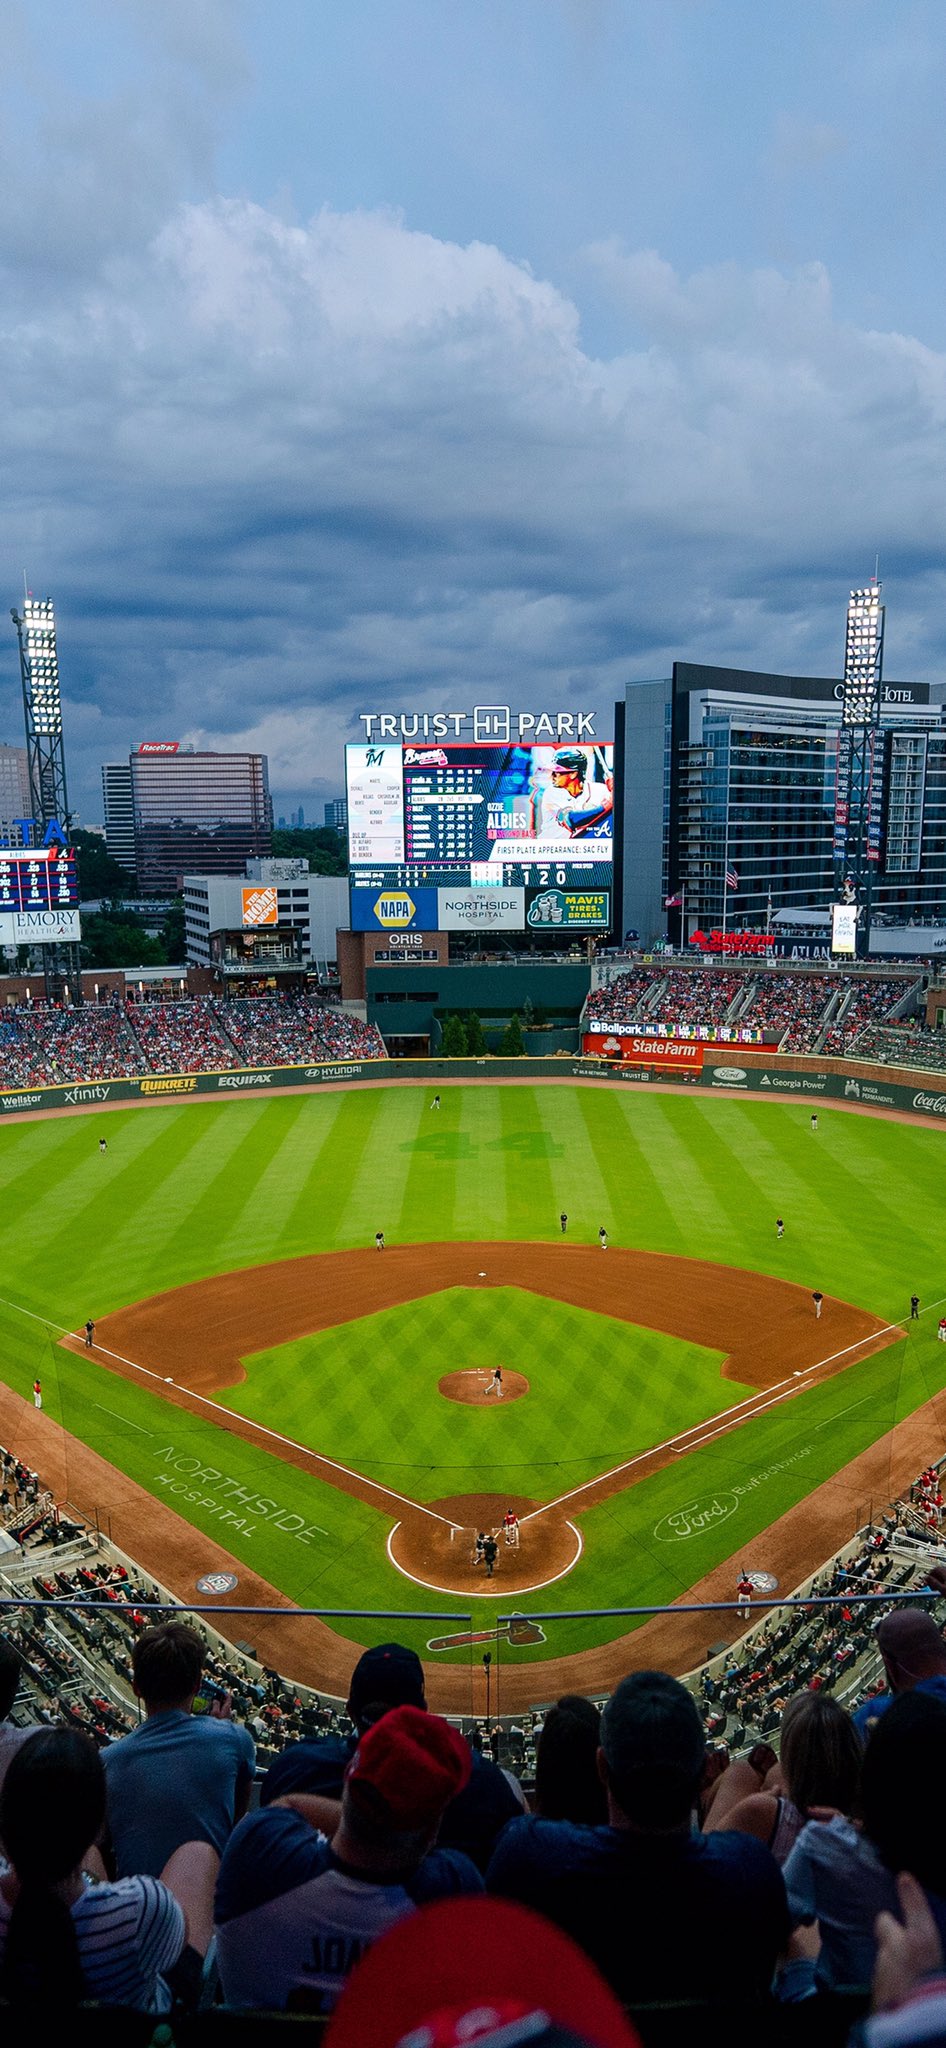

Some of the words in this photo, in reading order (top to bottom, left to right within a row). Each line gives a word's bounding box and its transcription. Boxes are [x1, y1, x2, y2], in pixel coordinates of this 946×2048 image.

[880, 686, 914, 702] HOTEL
[360, 713, 466, 737] TRUIST
[518, 712, 597, 736] PARK
[487, 802, 504, 811] OZZIE
[487, 813, 527, 829] ALBIES
[0, 819, 68, 845] TA
[521, 830, 537, 838] BASE
[497, 846, 515, 854] FIRST
[517, 846, 536, 854] PLATE
[538, 846, 582, 854] APPEARANCE:
[523, 871, 529, 885] 1
[539, 871, 549, 885] 2
[556, 871, 566, 885] 0
[243, 888, 277, 924] HOME
[245, 892, 260, 906] THE
[445, 901, 518, 910] NORTHSIDE
[565, 896, 604, 904] MAVIS
[381, 902, 409, 917] NAPA
[16, 911, 76, 927] EMORY
[18, 926, 75, 935] HEALTHCARE
[389, 934, 423, 944] ORIS
[601, 1022, 643, 1035] Ballpark
[321, 1065, 362, 1076] HYUNDAI
[720, 1069, 739, 1079] Ford
[140, 1078, 197, 1092] QUIKRETE
[218, 1074, 272, 1088] EQUIFAX
[772, 1078, 801, 1089] Georgia
[802, 1079, 825, 1090] Power
[64, 1086, 110, 1104] xfinity
[862, 1086, 879, 1094] KAISER
[2, 1094, 42, 1106] Wellstar
[912, 1092, 946, 1112] Coca-Co
[153, 1446, 329, 1545] NORTHSIDE
[153, 1473, 258, 1538] HOSPITAL
[668, 1500, 728, 1536] Ford
